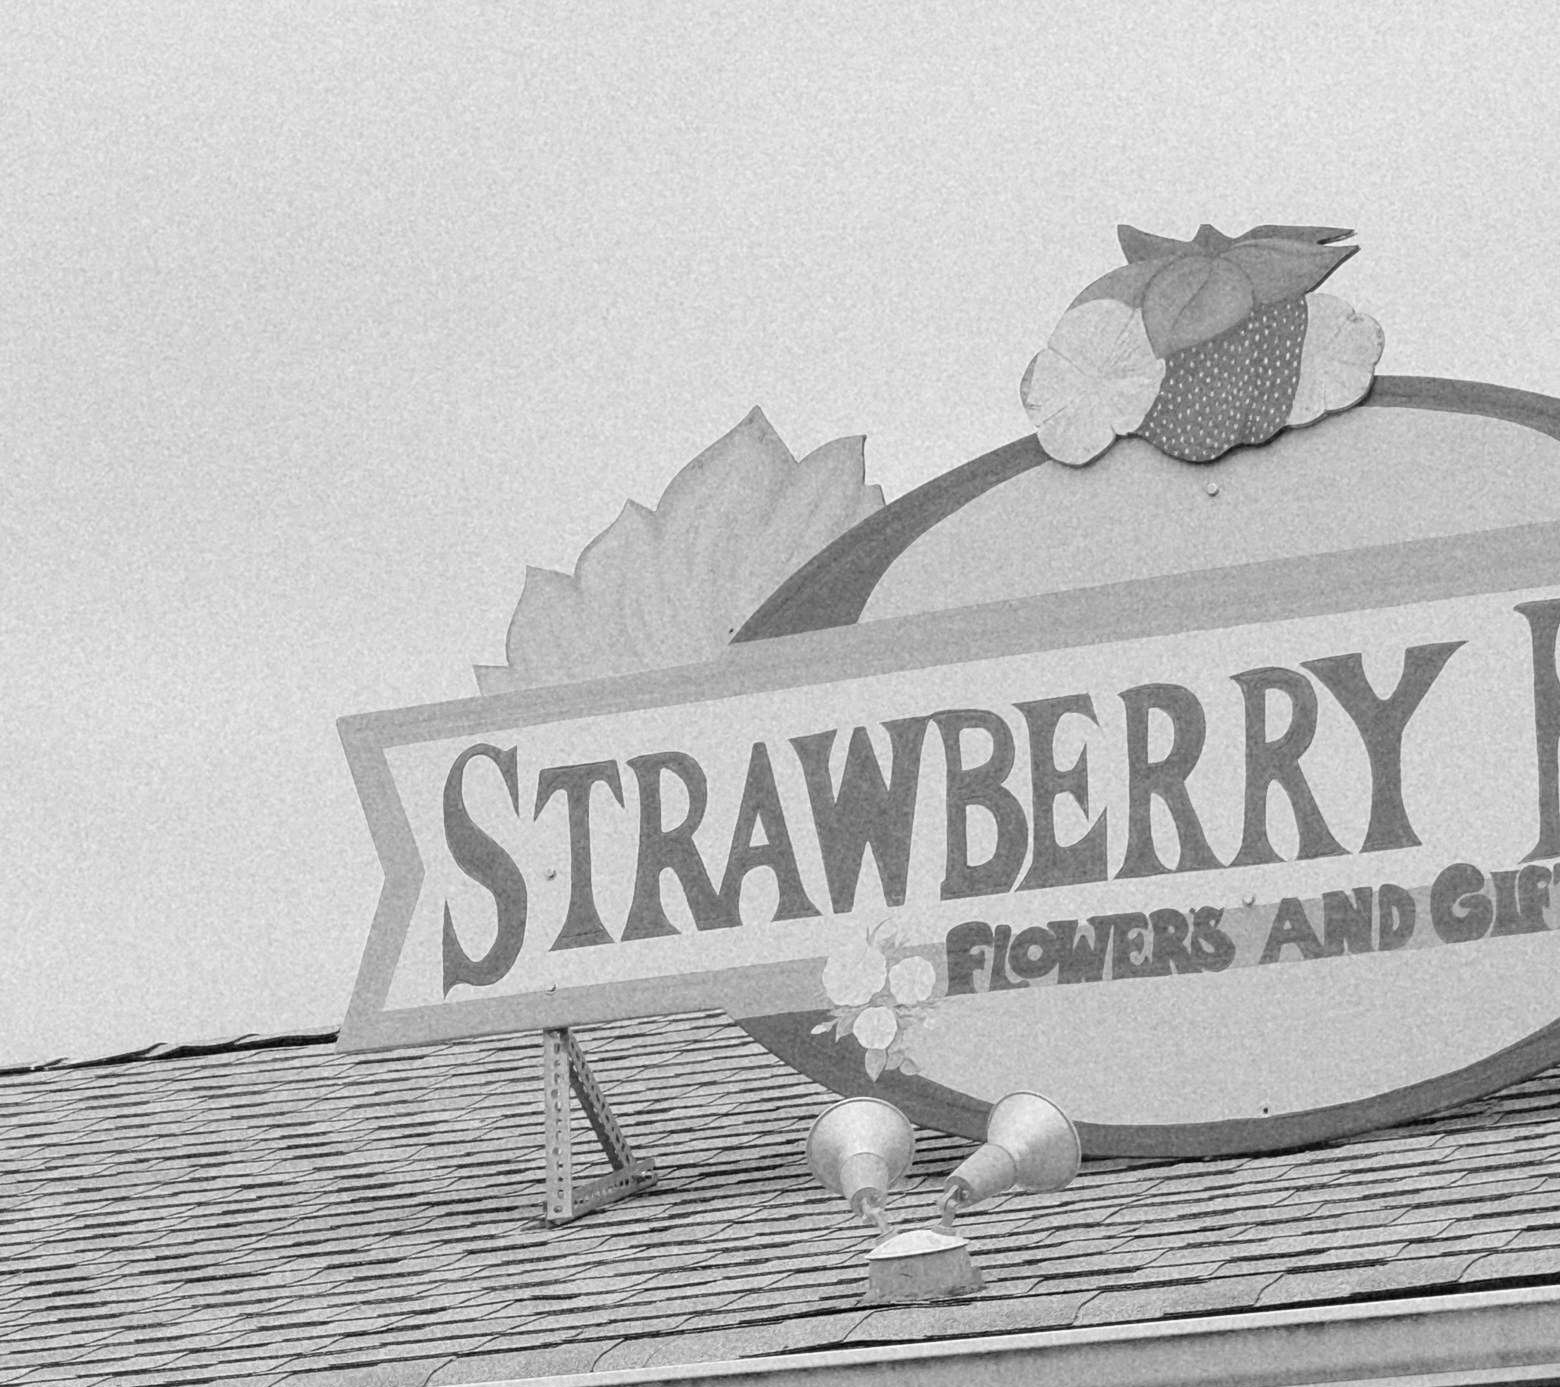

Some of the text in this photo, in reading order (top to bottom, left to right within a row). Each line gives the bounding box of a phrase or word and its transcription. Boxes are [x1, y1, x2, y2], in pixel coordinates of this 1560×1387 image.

[442, 640, 1469, 999] STRAWBERRY
[945, 906, 1236, 997] FLOWERS
[1258, 883, 1417, 966] AND
